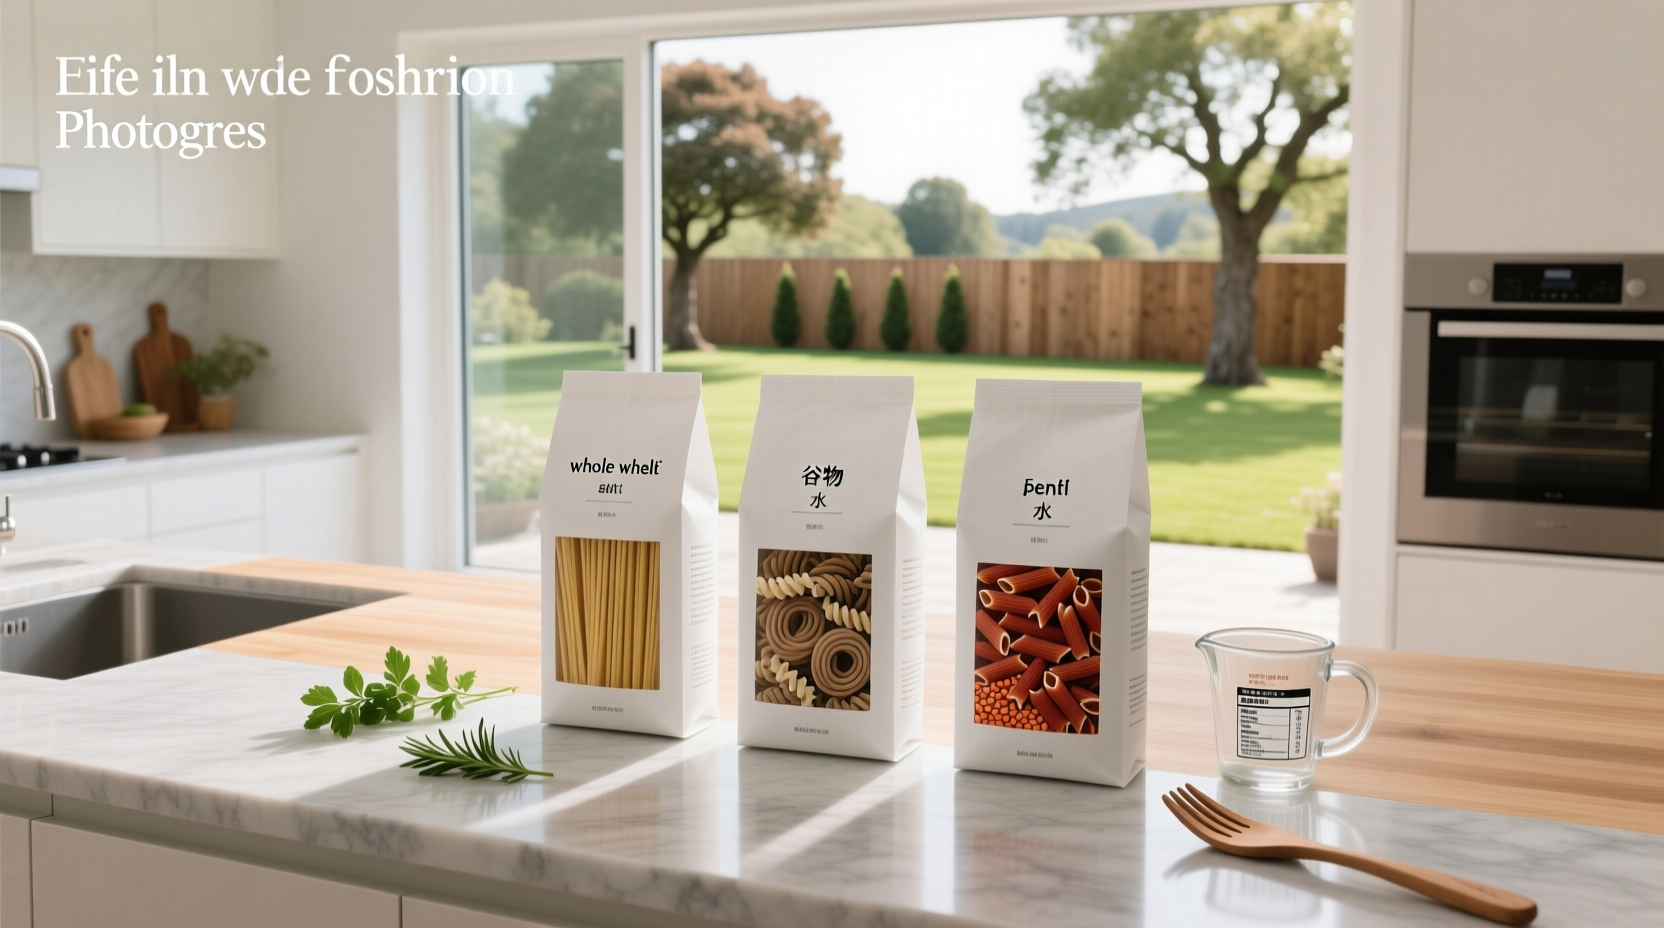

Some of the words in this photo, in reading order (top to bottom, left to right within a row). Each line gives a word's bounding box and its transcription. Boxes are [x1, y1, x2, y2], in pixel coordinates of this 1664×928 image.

[570, 457, 614, 473] whole
[801, 465, 844, 487] 谷物
[809, 491, 827, 509] 水
[1033, 501, 1052, 520] 水
